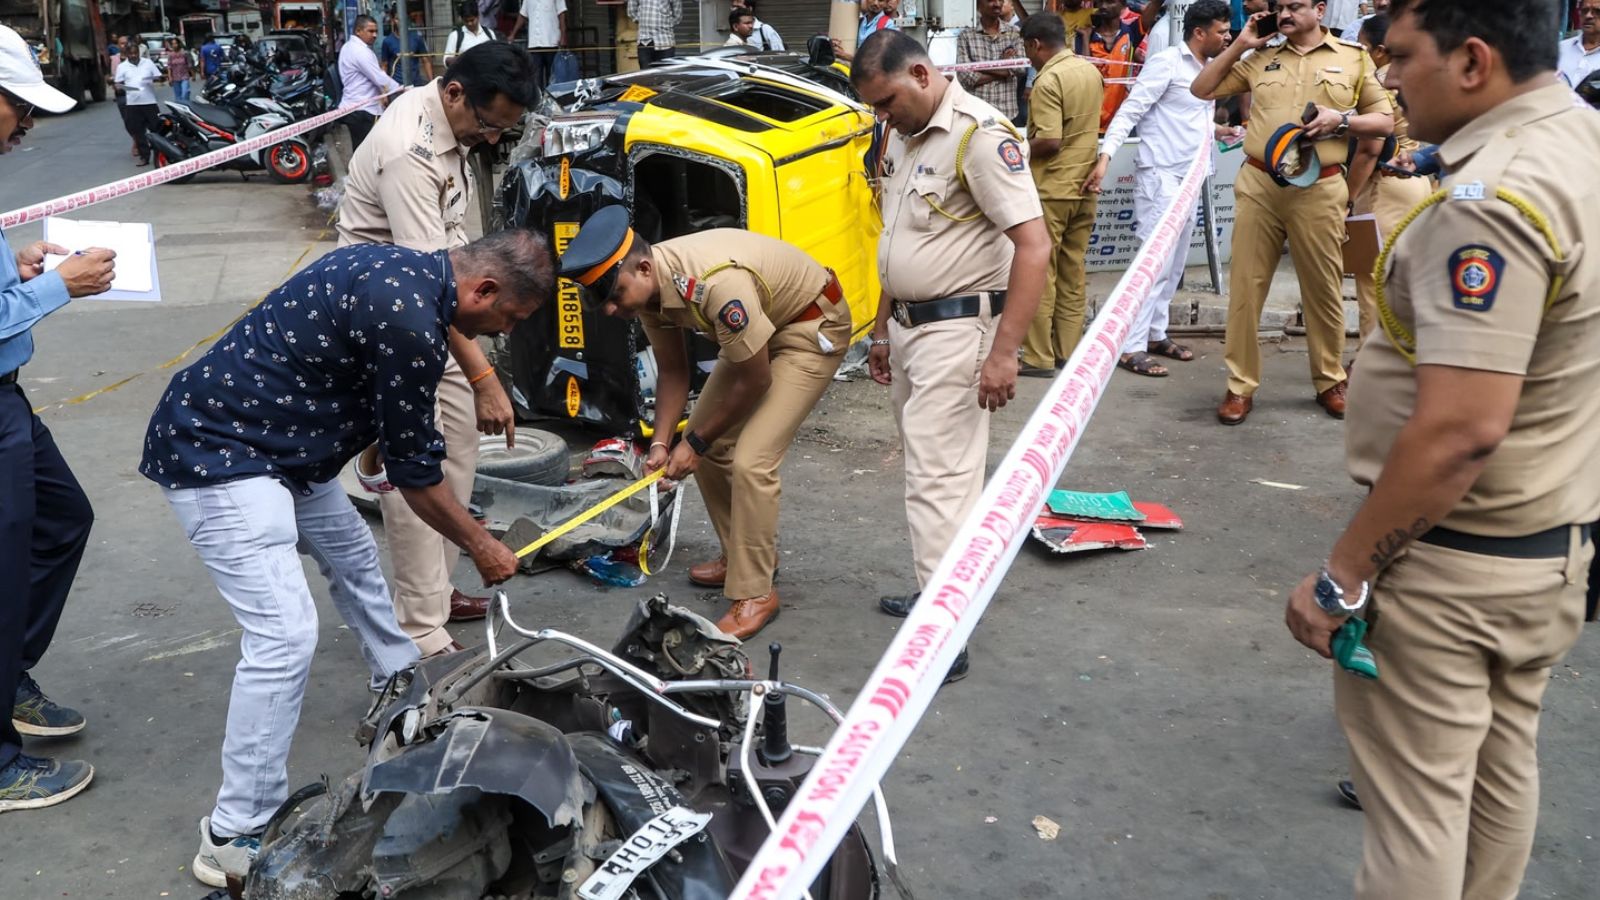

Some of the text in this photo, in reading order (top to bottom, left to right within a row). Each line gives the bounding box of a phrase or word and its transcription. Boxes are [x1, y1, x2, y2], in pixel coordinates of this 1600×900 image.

[1033, 423, 1056, 446] WORK
[996, 471, 1030, 510] CAUTION
[953, 536, 993, 583] DANGER
[899, 624, 942, 671] WORK
[807, 723, 881, 800] CAUTION
